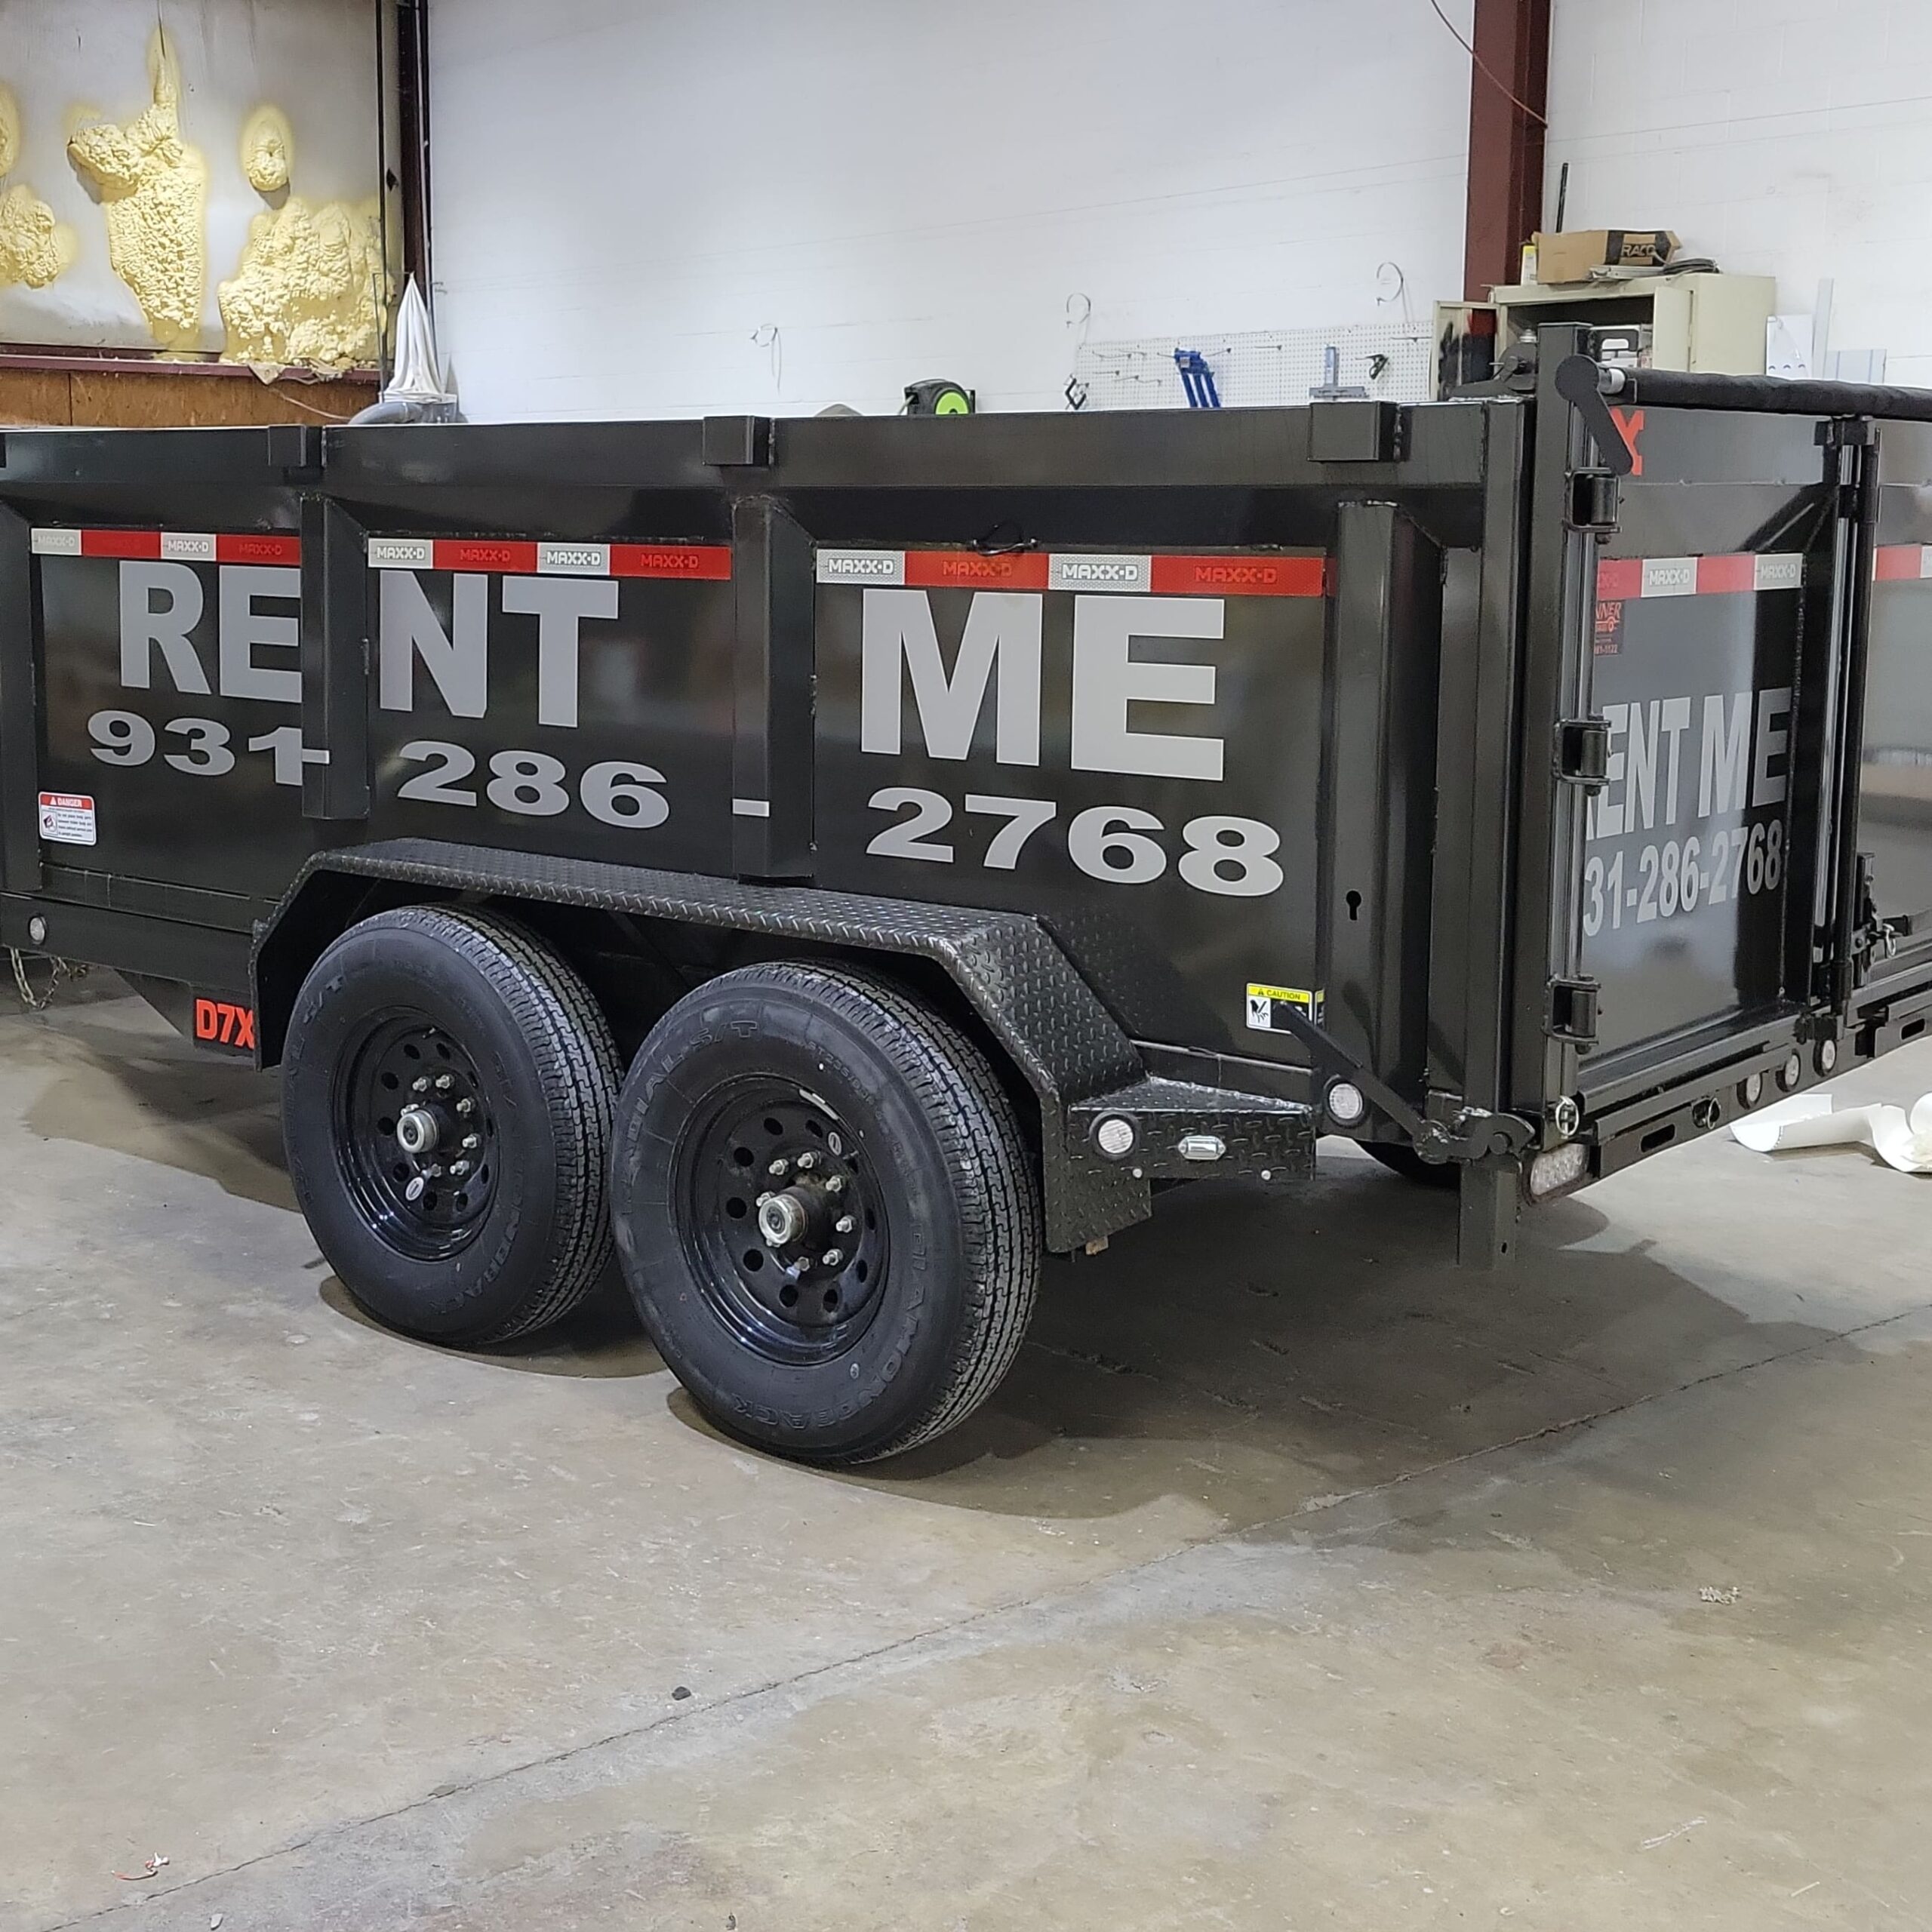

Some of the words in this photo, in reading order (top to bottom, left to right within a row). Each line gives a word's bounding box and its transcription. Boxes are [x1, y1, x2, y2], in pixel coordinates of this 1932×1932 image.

[861, 588, 1224, 781] ME
[57, 796, 83, 808] DANGER
[1586, 697, 1691, 841] ENT
[1698, 687, 1792, 817] ME
[397, 740, 670, 829] 286
[866, 786, 1284, 896] 2768
[1583, 820, 1783, 937] 31-286-2768
[196, 998, 254, 1050] D7X
[689, 1020, 758, 1051] S/T
[1266, 989, 1300, 1000] CAUTION
